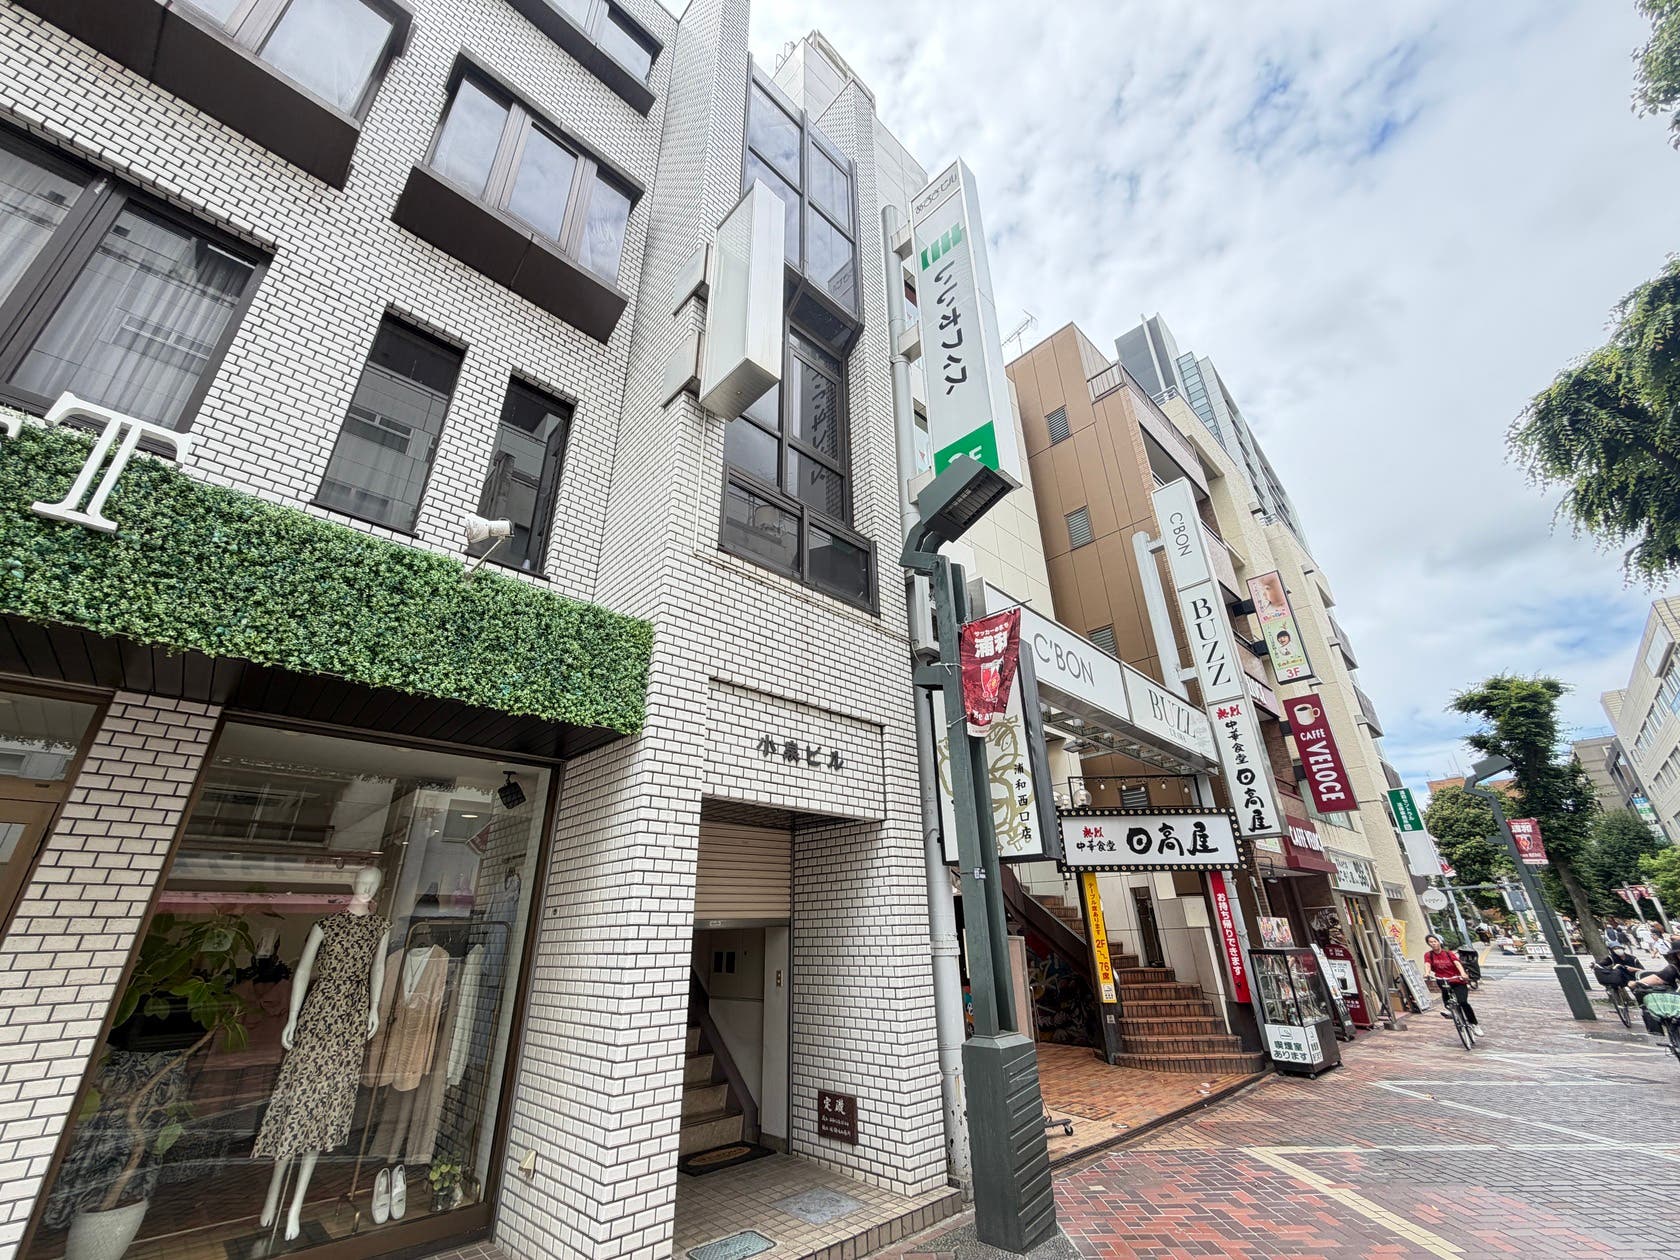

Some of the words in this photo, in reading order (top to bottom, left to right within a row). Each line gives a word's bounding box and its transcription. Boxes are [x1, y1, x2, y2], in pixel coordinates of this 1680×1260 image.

[934, 260, 968, 396] いいオフィス
[0, 389, 194, 534] T
[1169, 511, 1192, 558] C'BON
[1033, 632, 1095, 688] C'BON
[1191, 598, 1232, 687] BUZZ
[1286, 667, 1301, 678] 3F
[1148, 688, 1196, 738] BUZZ
[1225, 720, 1249, 765] 中華食堂
[1306, 740, 1345, 802] VELOCE
[1014, 763, 1032, 840] 浦和西口店
[1076, 840, 1117, 853] 中華食堂
[1096, 940, 1106, 949] 2F
[1217, 893, 1242, 976] お持ち帰りできます
[1099, 962, 1110, 972] 76
[1273, 1050, 1308, 1061] あります
